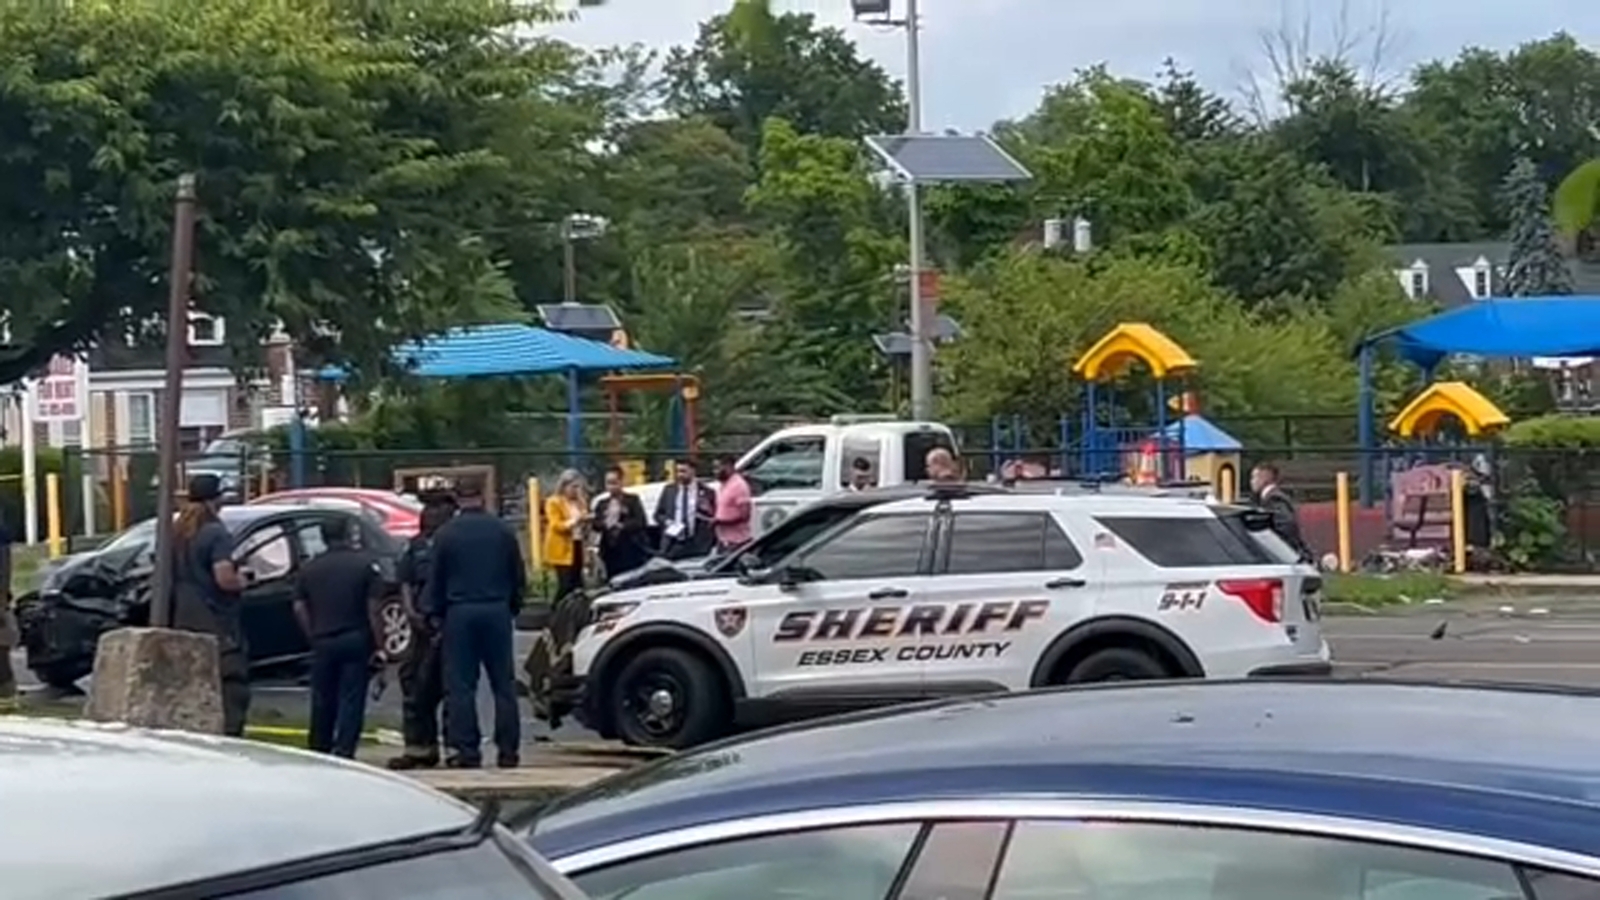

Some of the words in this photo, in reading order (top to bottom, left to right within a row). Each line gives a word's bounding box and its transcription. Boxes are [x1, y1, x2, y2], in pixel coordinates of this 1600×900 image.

[1157, 592, 1207, 611] 9-1-1
[773, 599, 1050, 642] SHERIFF
[797, 647, 889, 667] ESSEX
[896, 641, 1011, 661] COUNTY
